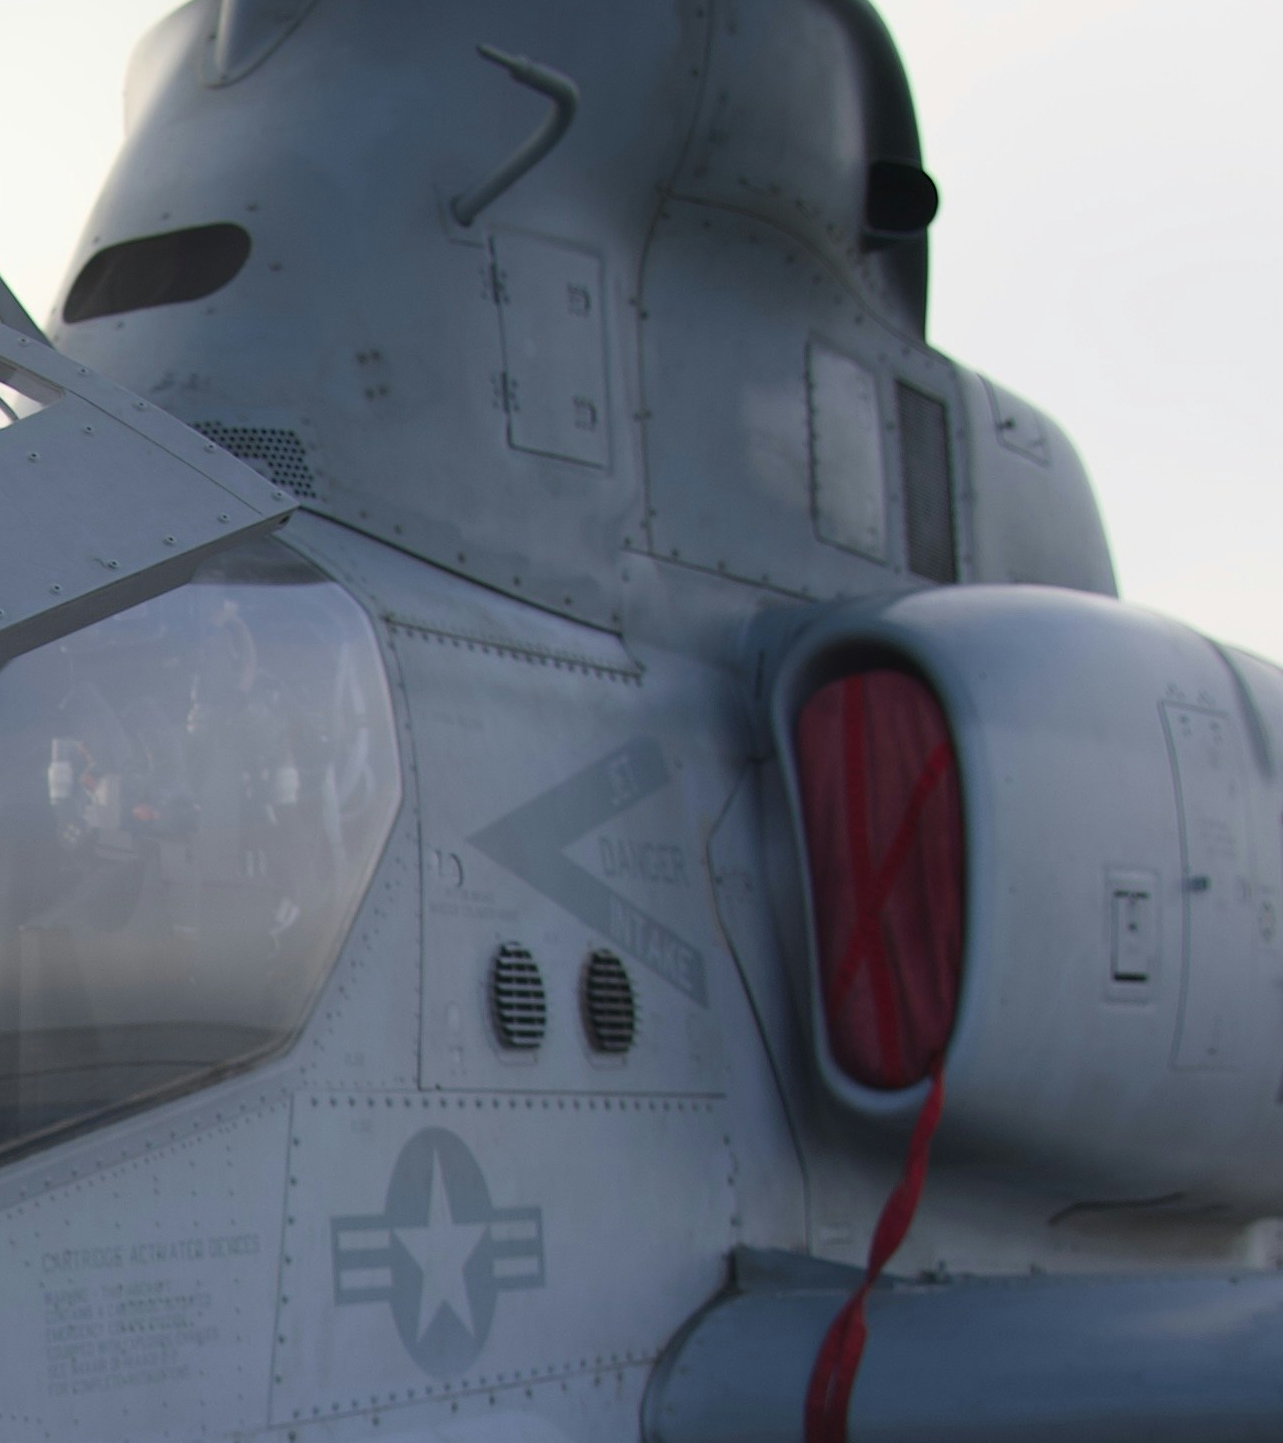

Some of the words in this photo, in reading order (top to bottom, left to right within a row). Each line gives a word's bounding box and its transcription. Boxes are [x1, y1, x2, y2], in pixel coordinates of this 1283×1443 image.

[597, 835, 690, 887] DANGER
[41, 1245, 123, 1273] CARTRIDGE
[129, 1237, 204, 1265] ACTIVATED
[208, 1233, 261, 1258] DEVICES
